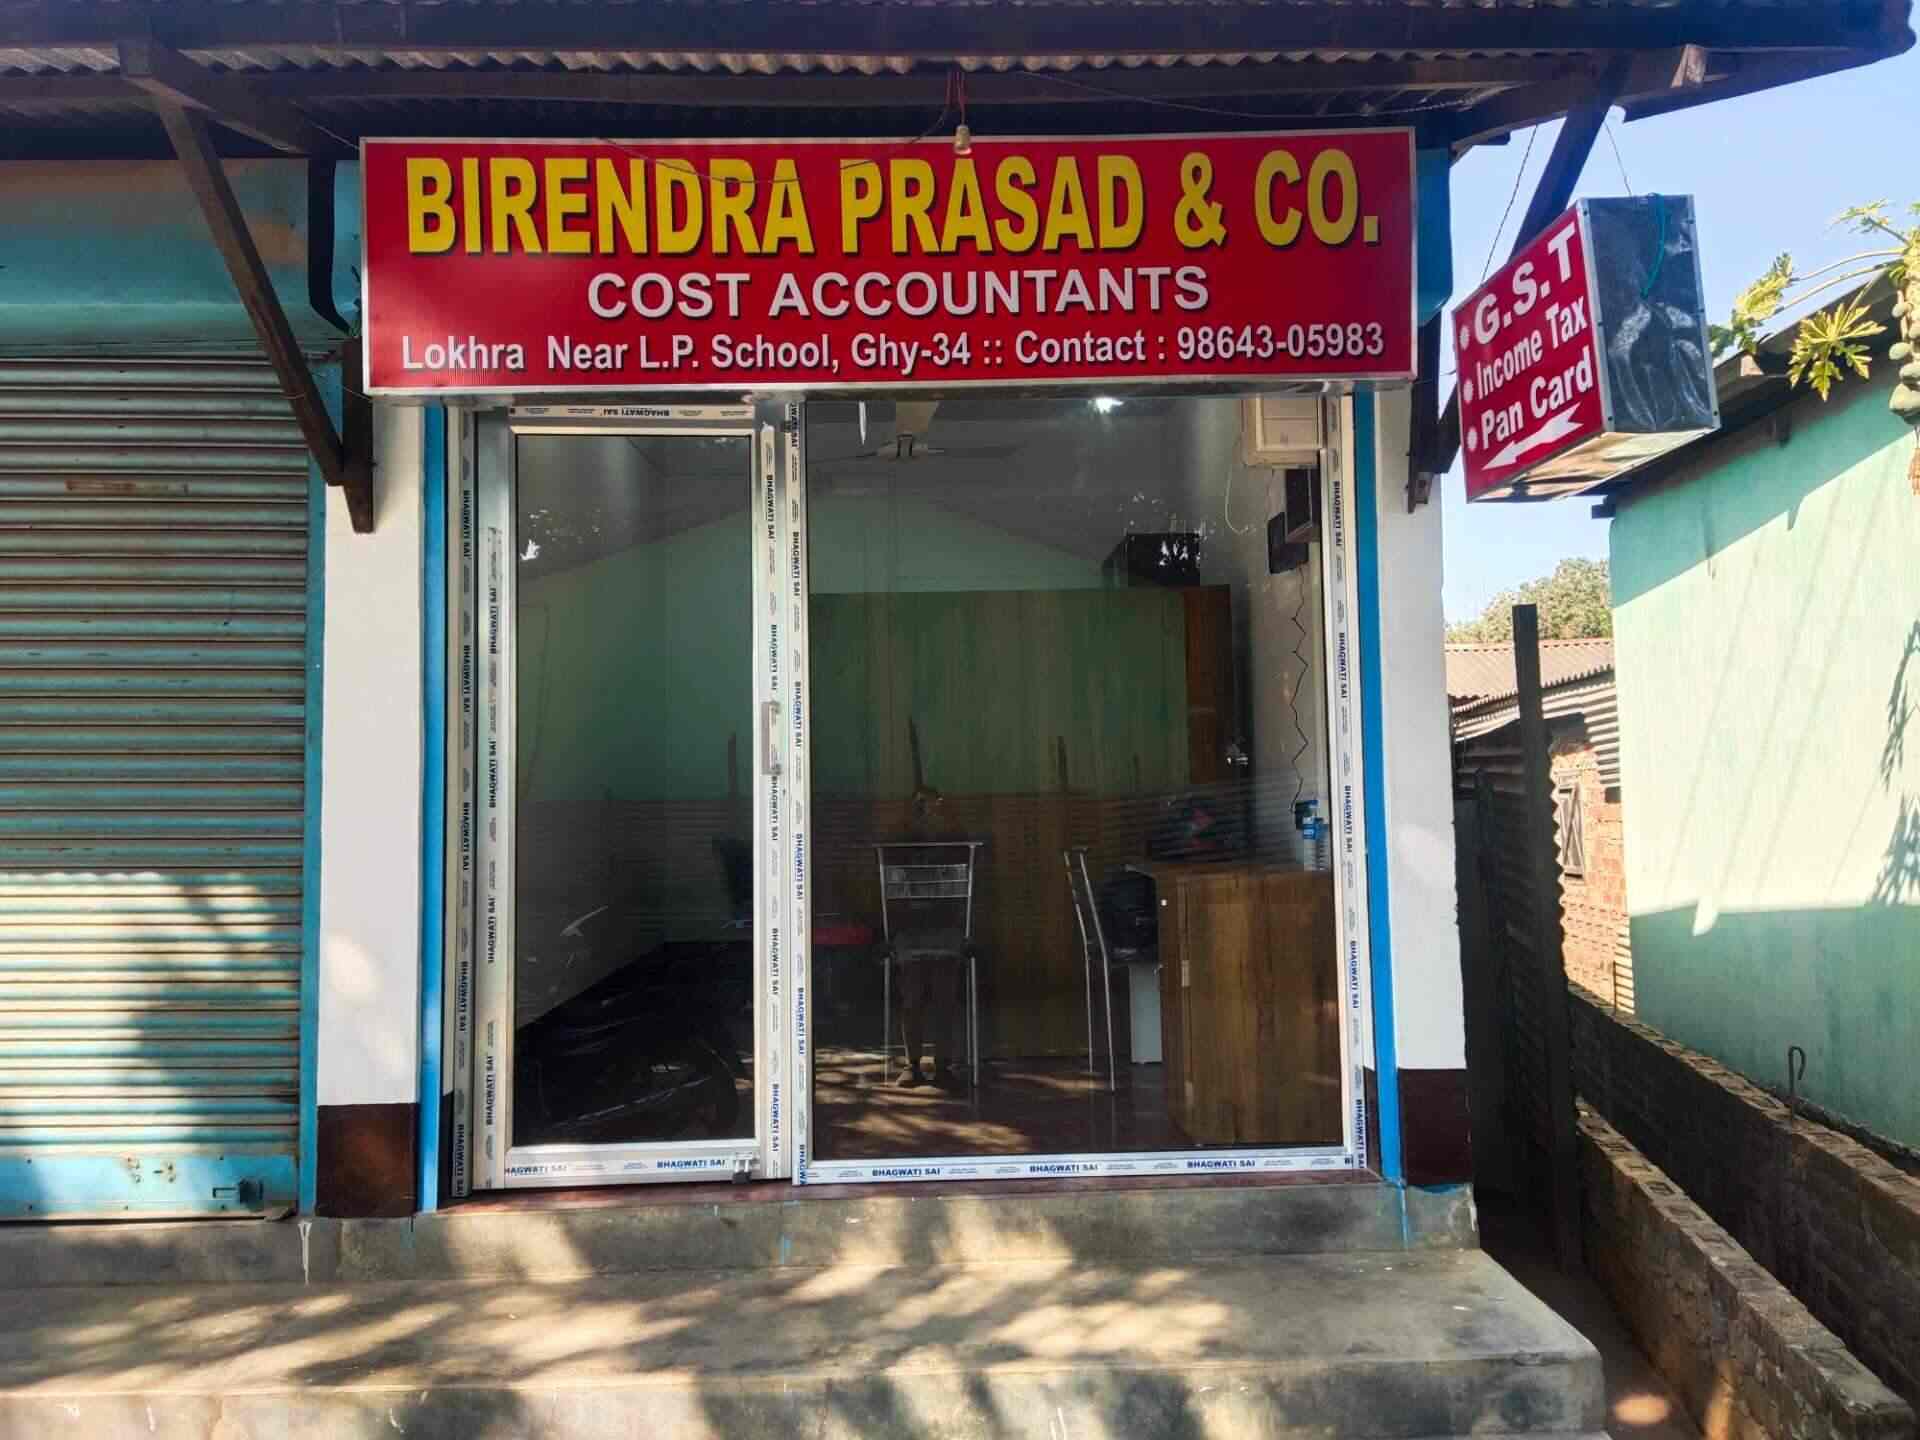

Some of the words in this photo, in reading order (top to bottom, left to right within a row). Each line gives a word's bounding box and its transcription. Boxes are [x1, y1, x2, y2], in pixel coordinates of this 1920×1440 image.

[406, 157, 814, 254] BIRENDRA
[840, 154, 1144, 253] PRASAD
[1174, 151, 1227, 249] &
[1254, 148, 1379, 247] CO.
[1474, 222, 1575, 344] G.S.T
[587, 272, 750, 318] COST
[768, 265, 1209, 318] ACCOUNTANTS
[402, 335, 524, 370] Lokhra
[547, 336, 628, 370] Near
[640, 335, 698, 369] L.P.
[712, 333, 840, 373] School,
[851, 332, 971, 374] Ghy-34
[1016, 329, 1145, 364] Contact
[1177, 322, 1384, 360] 98643-05983
[1477, 329, 1543, 400] Income
[1546, 296, 1588, 350] Tax
[1481, 402, 1524, 449] Pan
[1530, 346, 1593, 419] Card
[463, 542, 471, 558] SAI
[793, 582, 801, 597] SAI
[770, 675, 778, 690] SAI
[1339, 683, 1347, 698] SAI
[463, 697, 471, 713] SAI
[489, 741, 497, 756] SAI
[771, 825, 779, 841] SAI
[1344, 837, 1352, 853] SAI
[462, 855, 470, 871] SAI
[796, 884, 804, 900] SAI
[771, 980, 779, 995] SAI
[1350, 993, 1359, 1009] SAI
[460, 1016, 468, 1031] SAI
[797, 1040, 805, 1055] SAI
[486, 1056, 494, 1071] SAI
[711, 1159, 726, 1167] SAI
[1082, 1163, 1098, 1171] SAI
[1240, 1160, 1255, 1168] SAI
